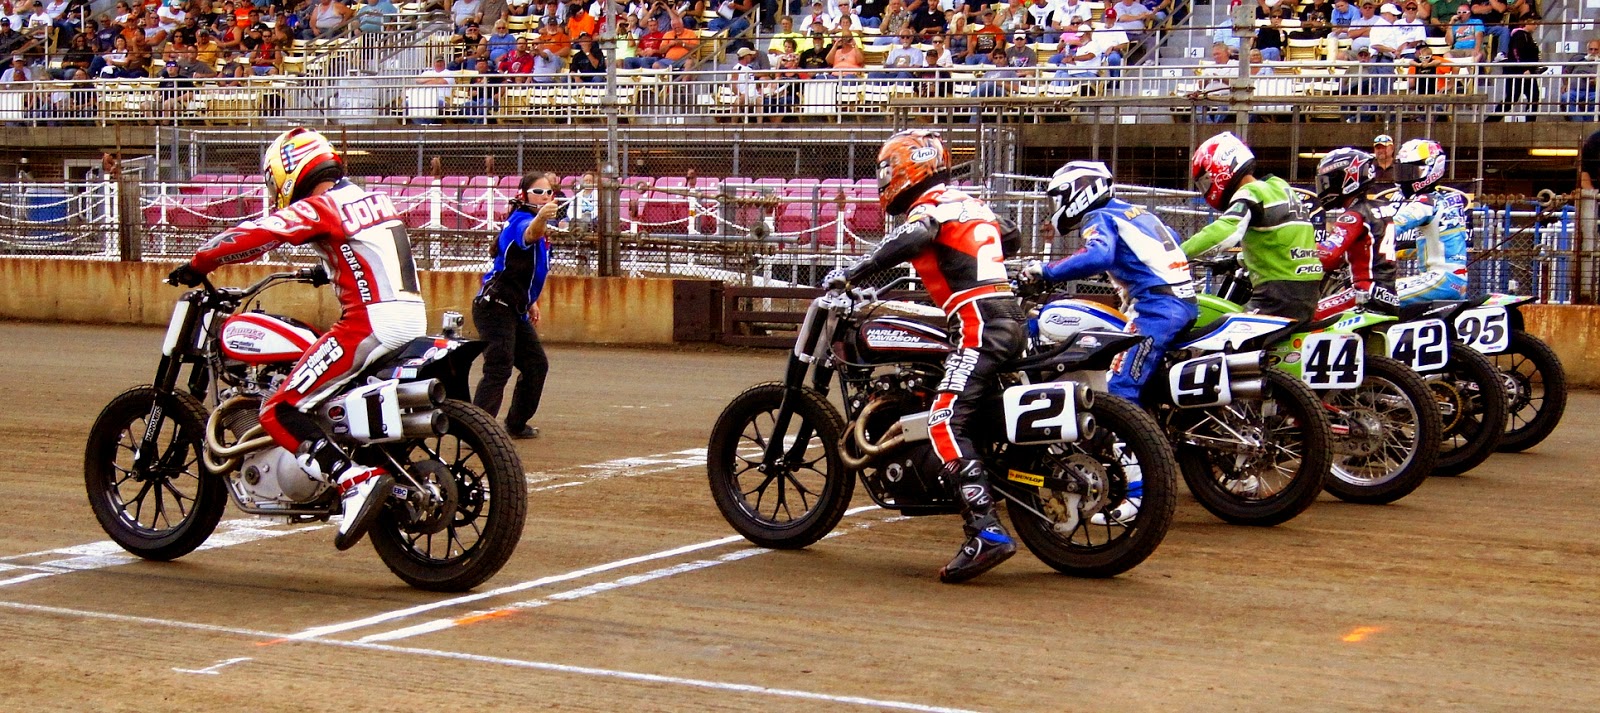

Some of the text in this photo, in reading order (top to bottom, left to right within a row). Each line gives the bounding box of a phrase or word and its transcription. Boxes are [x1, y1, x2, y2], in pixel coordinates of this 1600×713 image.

[1065, 178, 1109, 218] BELL
[1412, 177, 1432, 191] Red
[340, 244, 361, 271] GENE
[357, 280, 371, 302] GAIL
[974, 223, 1008, 281] 2
[866, 334, 920, 343] DAVIDSON
[1392, 324, 1443, 367] 42
[1458, 312, 1506, 346] 95
[313, 345, 344, 376] H-D
[1177, 356, 1223, 406] 9
[1305, 339, 1359, 384] 44
[362, 386, 390, 439] 1
[1015, 387, 1066, 443] 2
[1015, 473, 1043, 483] DUNLOP
